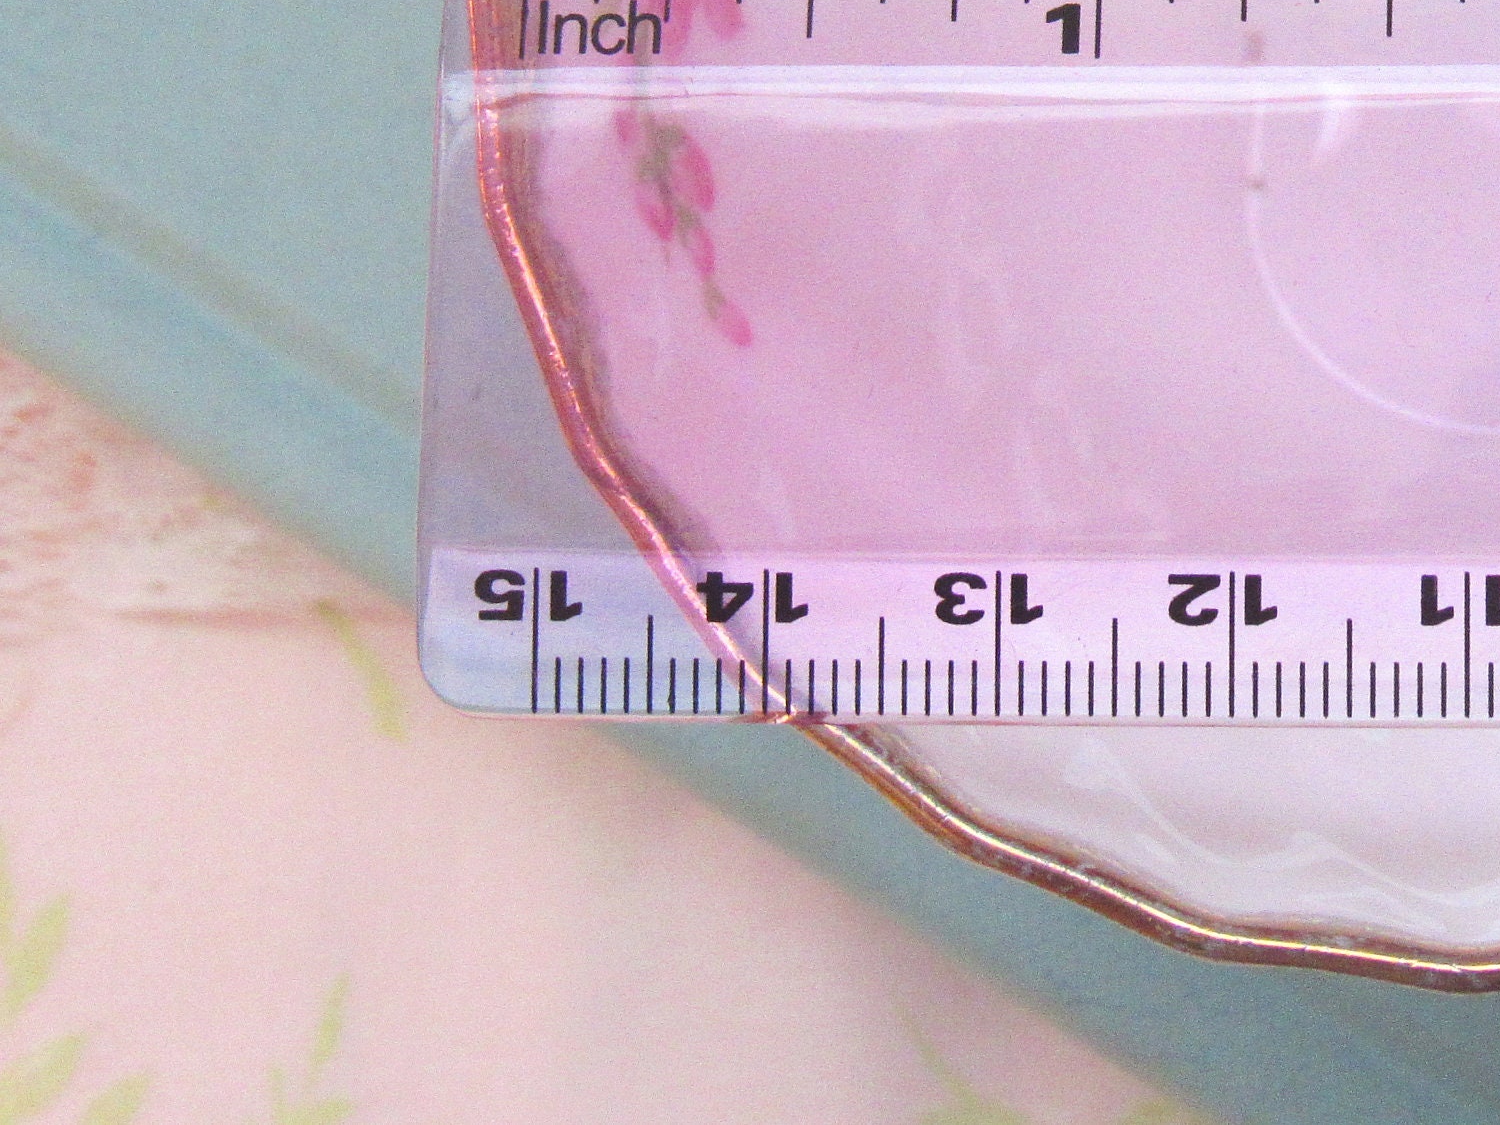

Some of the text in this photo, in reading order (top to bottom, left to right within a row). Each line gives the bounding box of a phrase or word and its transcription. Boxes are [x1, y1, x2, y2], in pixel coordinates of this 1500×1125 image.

[536, 0, 662, 55] Inch
[1045, 3, 1082, 55] 1
[473, 569, 583, 622] 15
[696, 571, 809, 623] 14
[933, 571, 1044, 625] 13
[1167, 574, 1278, 627] 12
